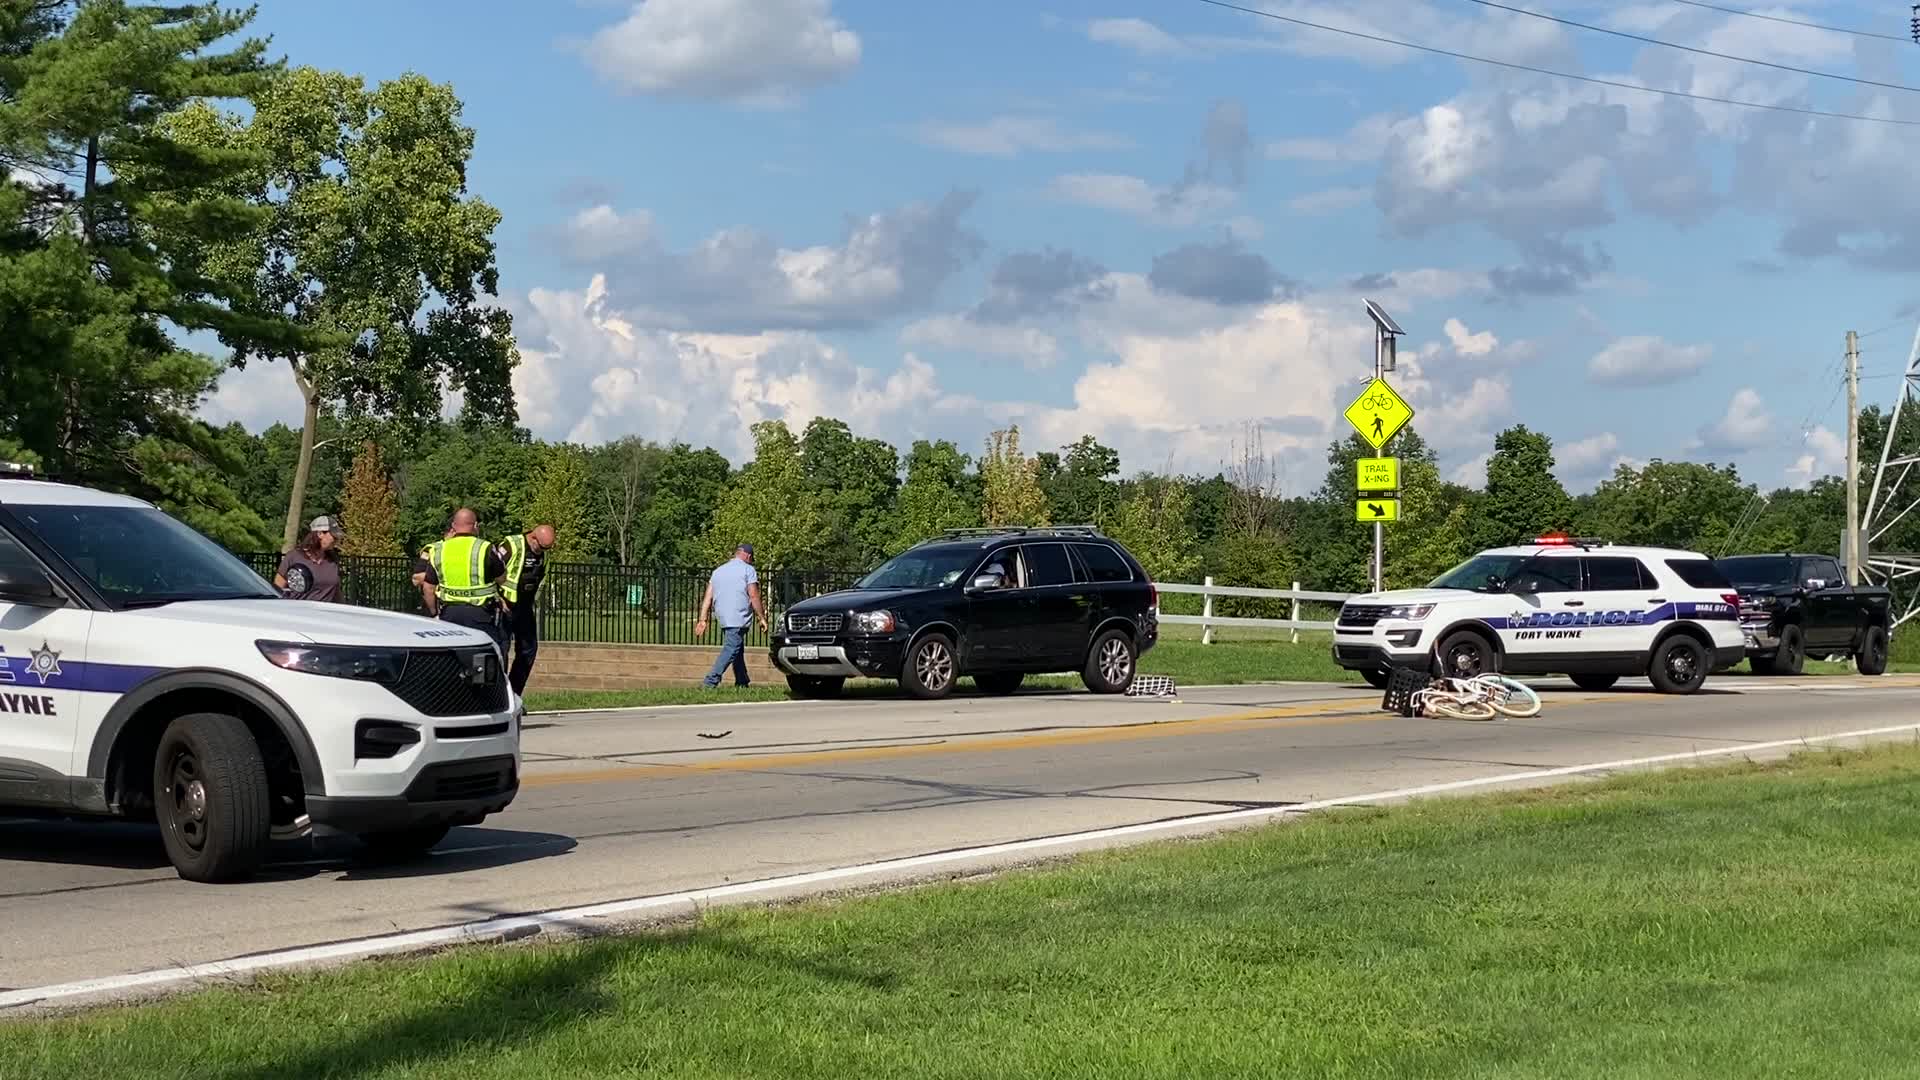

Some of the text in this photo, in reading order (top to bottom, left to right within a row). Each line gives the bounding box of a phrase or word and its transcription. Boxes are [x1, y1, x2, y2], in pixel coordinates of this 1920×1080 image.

[1364, 464, 1388, 473] TRAIL
[1364, 474, 1390, 483] X-ING
[1527, 609, 1645, 627] POLICE
[1515, 630, 1582, 640] FORT WAYNE
